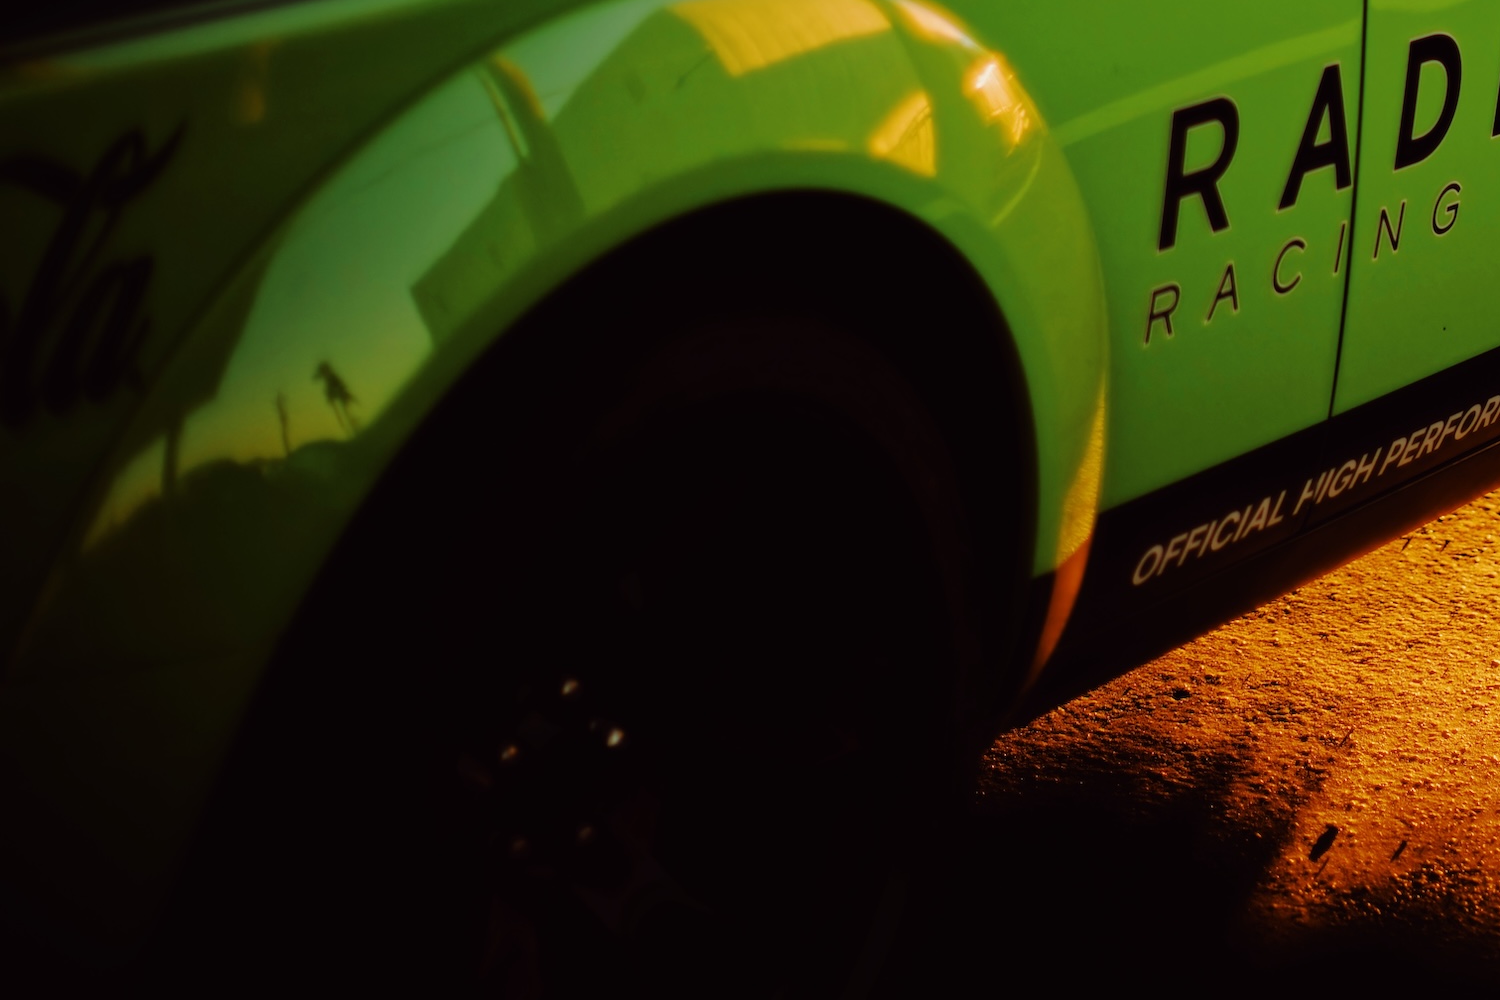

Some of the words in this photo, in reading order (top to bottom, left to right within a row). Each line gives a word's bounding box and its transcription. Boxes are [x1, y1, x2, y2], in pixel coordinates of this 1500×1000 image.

[1143, 181, 1463, 346] RACING
[1131, 488, 1289, 587] OFFICIAL
[1292, 446, 1384, 516] HIGH
